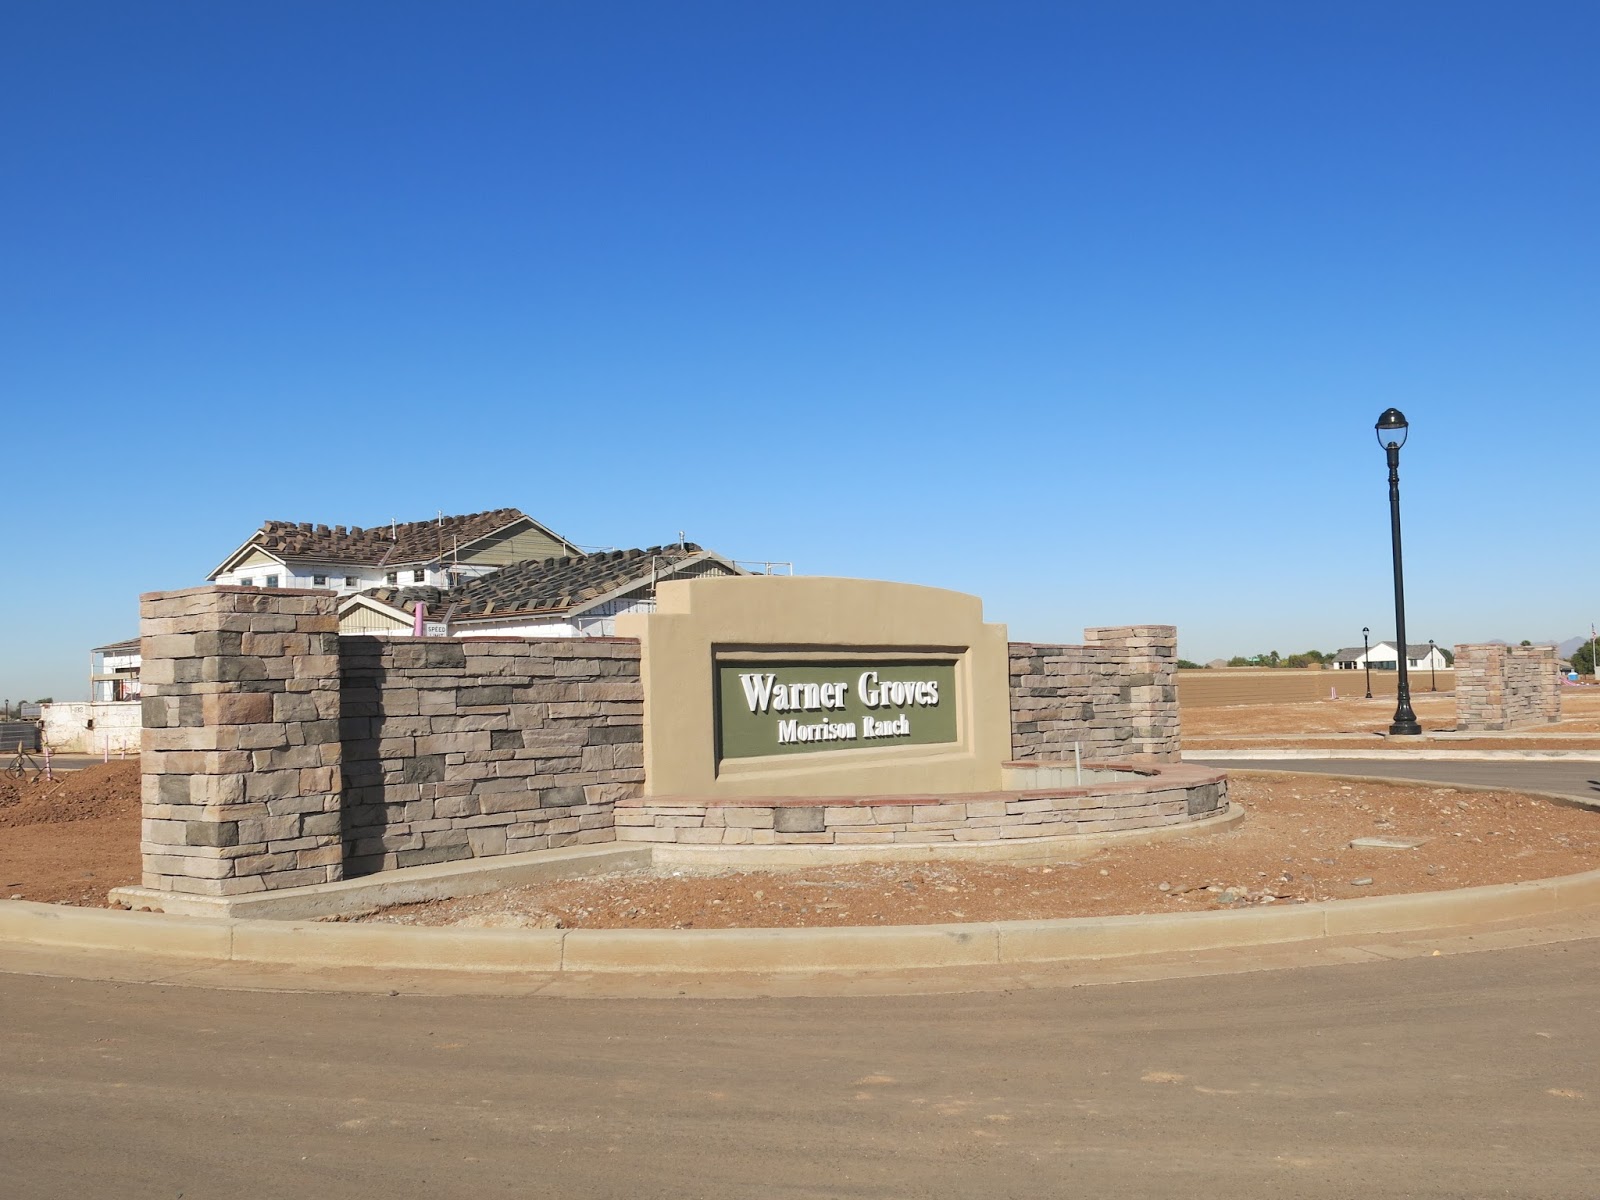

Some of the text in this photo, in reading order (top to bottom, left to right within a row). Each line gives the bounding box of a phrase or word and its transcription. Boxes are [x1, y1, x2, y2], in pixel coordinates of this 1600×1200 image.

[739, 671, 940, 712] Warner Groves
[777, 713, 911, 743] Morrison Ranch
